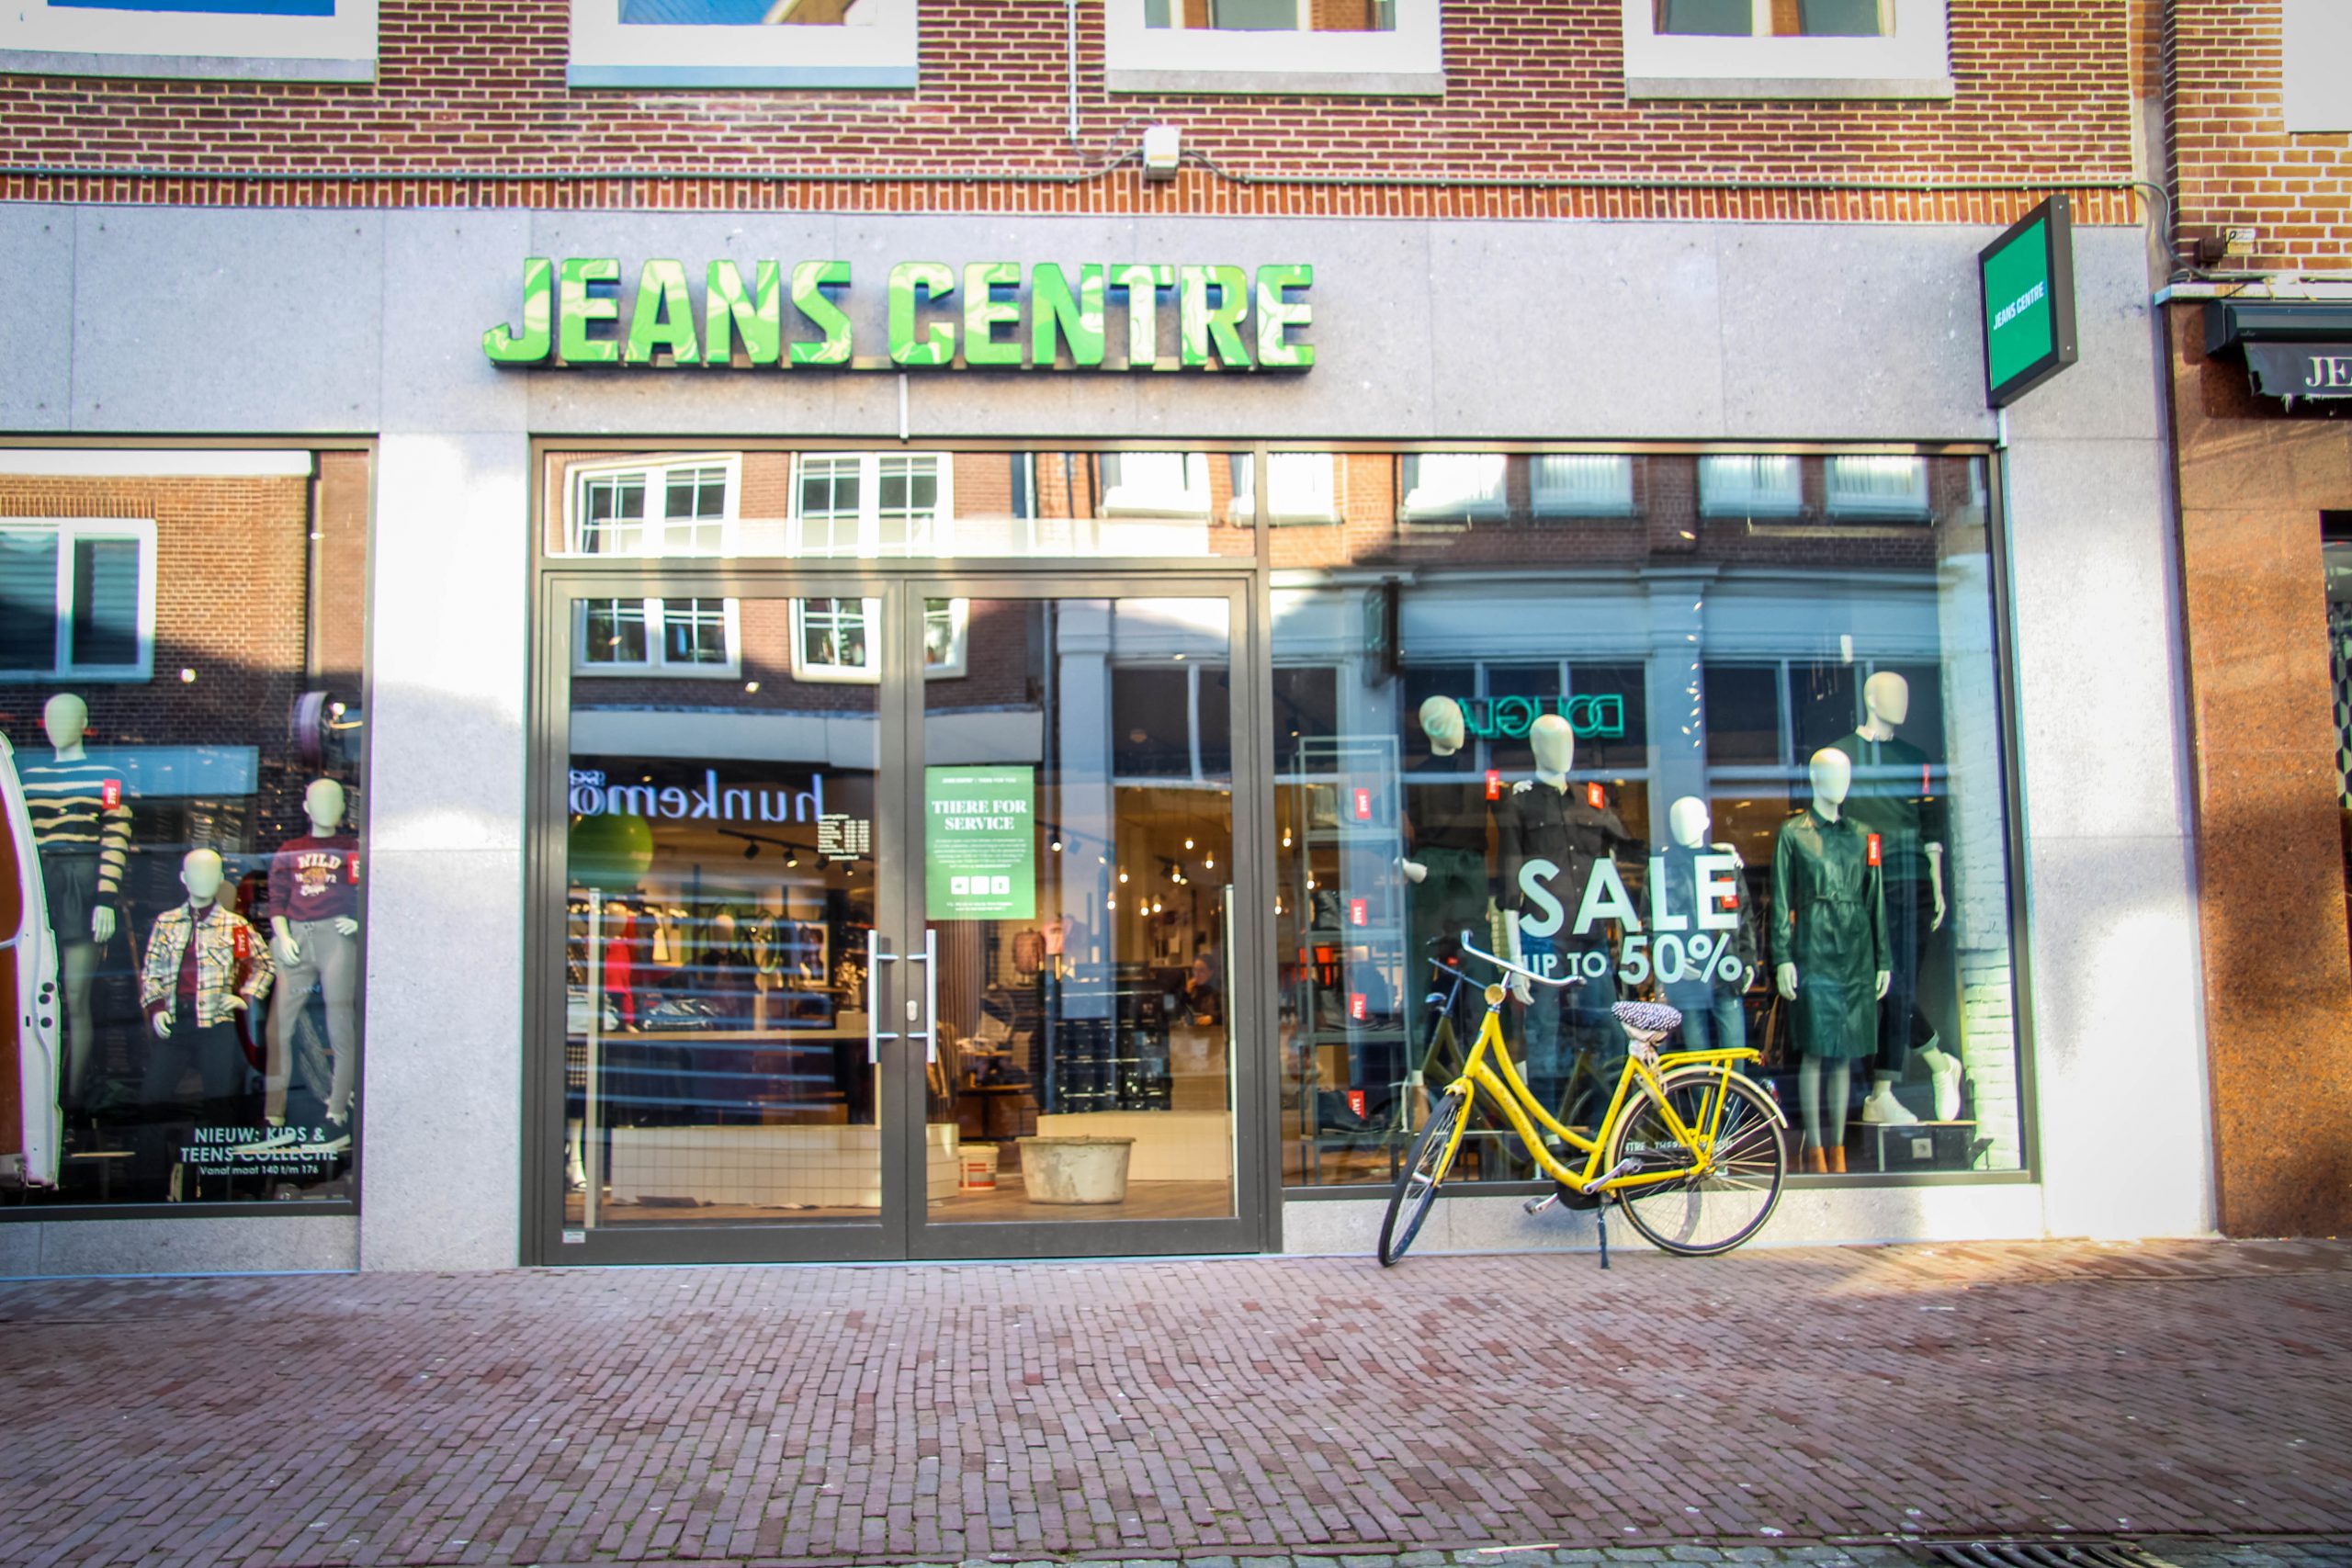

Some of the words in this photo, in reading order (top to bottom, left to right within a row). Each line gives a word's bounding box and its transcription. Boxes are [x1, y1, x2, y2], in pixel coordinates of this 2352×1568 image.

[482, 257, 852, 366] JEANS
[888, 261, 1316, 367] CENTRE
[1993, 301, 2017, 331] JEANS
[2016, 280, 2045, 314] CENTRE
[107, 786, 117, 805] SALE
[932, 800, 989, 814] THERE
[992, 799, 1027, 814] FOR
[944, 816, 1014, 830] SERVICE
[297, 853, 342, 870] WILD
[1518, 853, 1739, 938] SALE
[1566, 952, 1607, 978] TO
[1618, 931, 1743, 986] 50%
[195, 1127, 260, 1144] NIEUW:
[266, 1126, 308, 1143] KIDS
[313, 1126, 326, 1143] &
[180, 1145, 234, 1163] TEENS
[199, 1166, 230, 1176] Vanaf
[232, 1166, 259, 1175] maat
[262, 1165, 279, 1175] 140
[281, 1164, 300, 1175] t/m
[302, 1164, 319, 1174] 176
